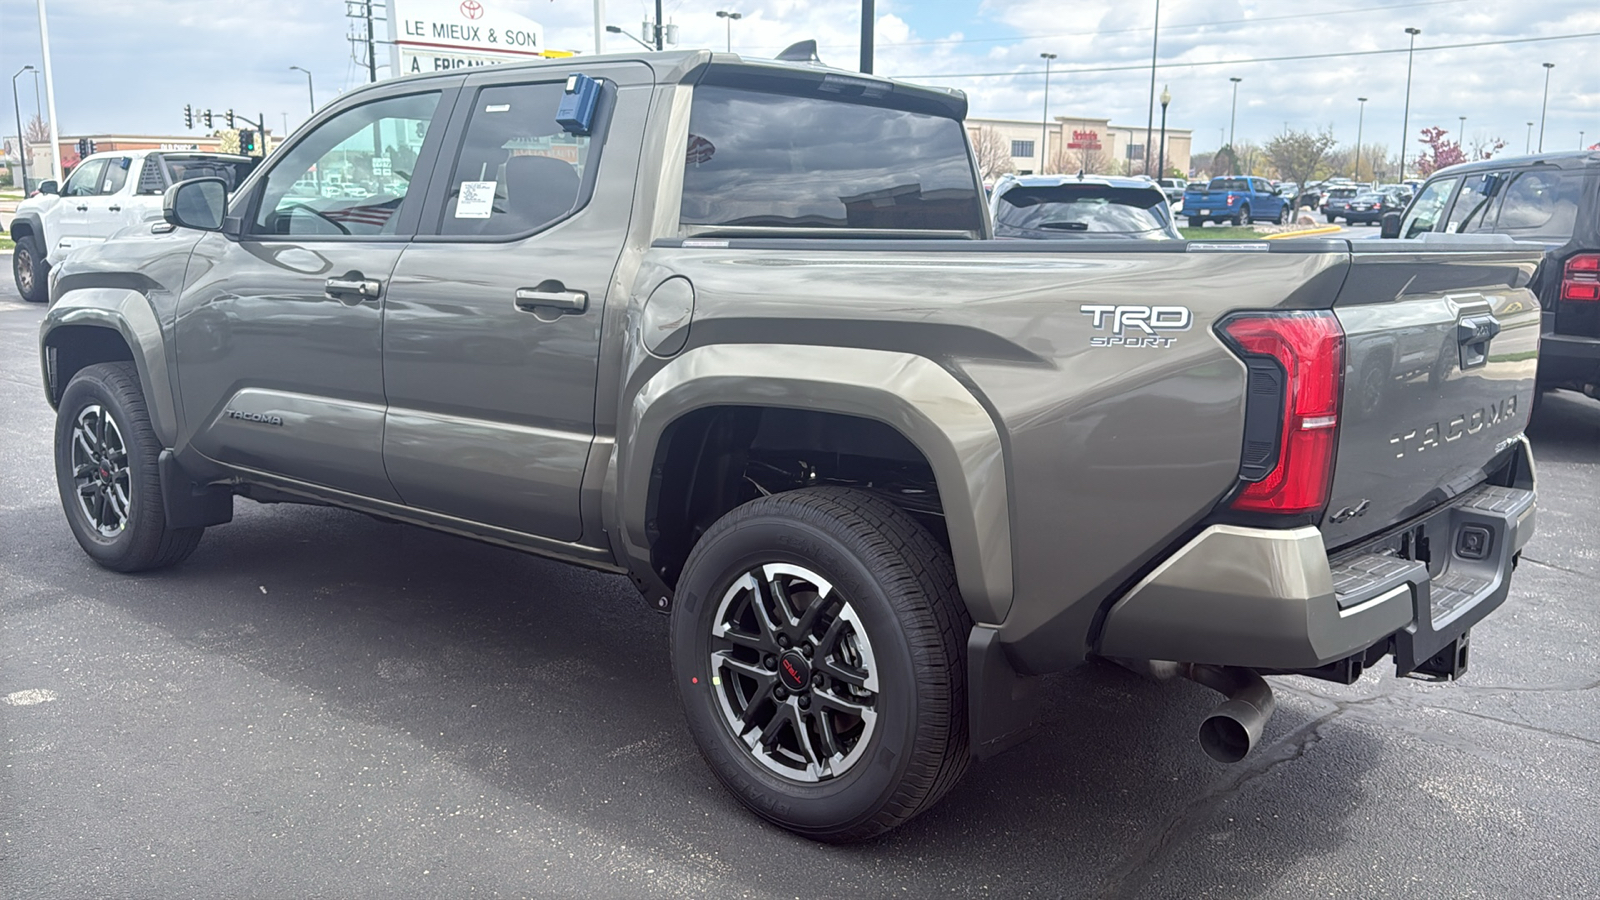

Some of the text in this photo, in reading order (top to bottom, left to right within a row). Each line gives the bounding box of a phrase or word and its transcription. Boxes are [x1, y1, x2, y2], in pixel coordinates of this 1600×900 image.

[405, 20, 537, 47] LE MIEUX & SON
[411, 56, 421, 73] A
[1080, 304, 1193, 337] TRD
[1090, 336, 1178, 348] SPORT
[226, 409, 284, 427] TACOMA
[1389, 394, 1518, 459] TACOMA
[782, 658, 802, 684] TRD
